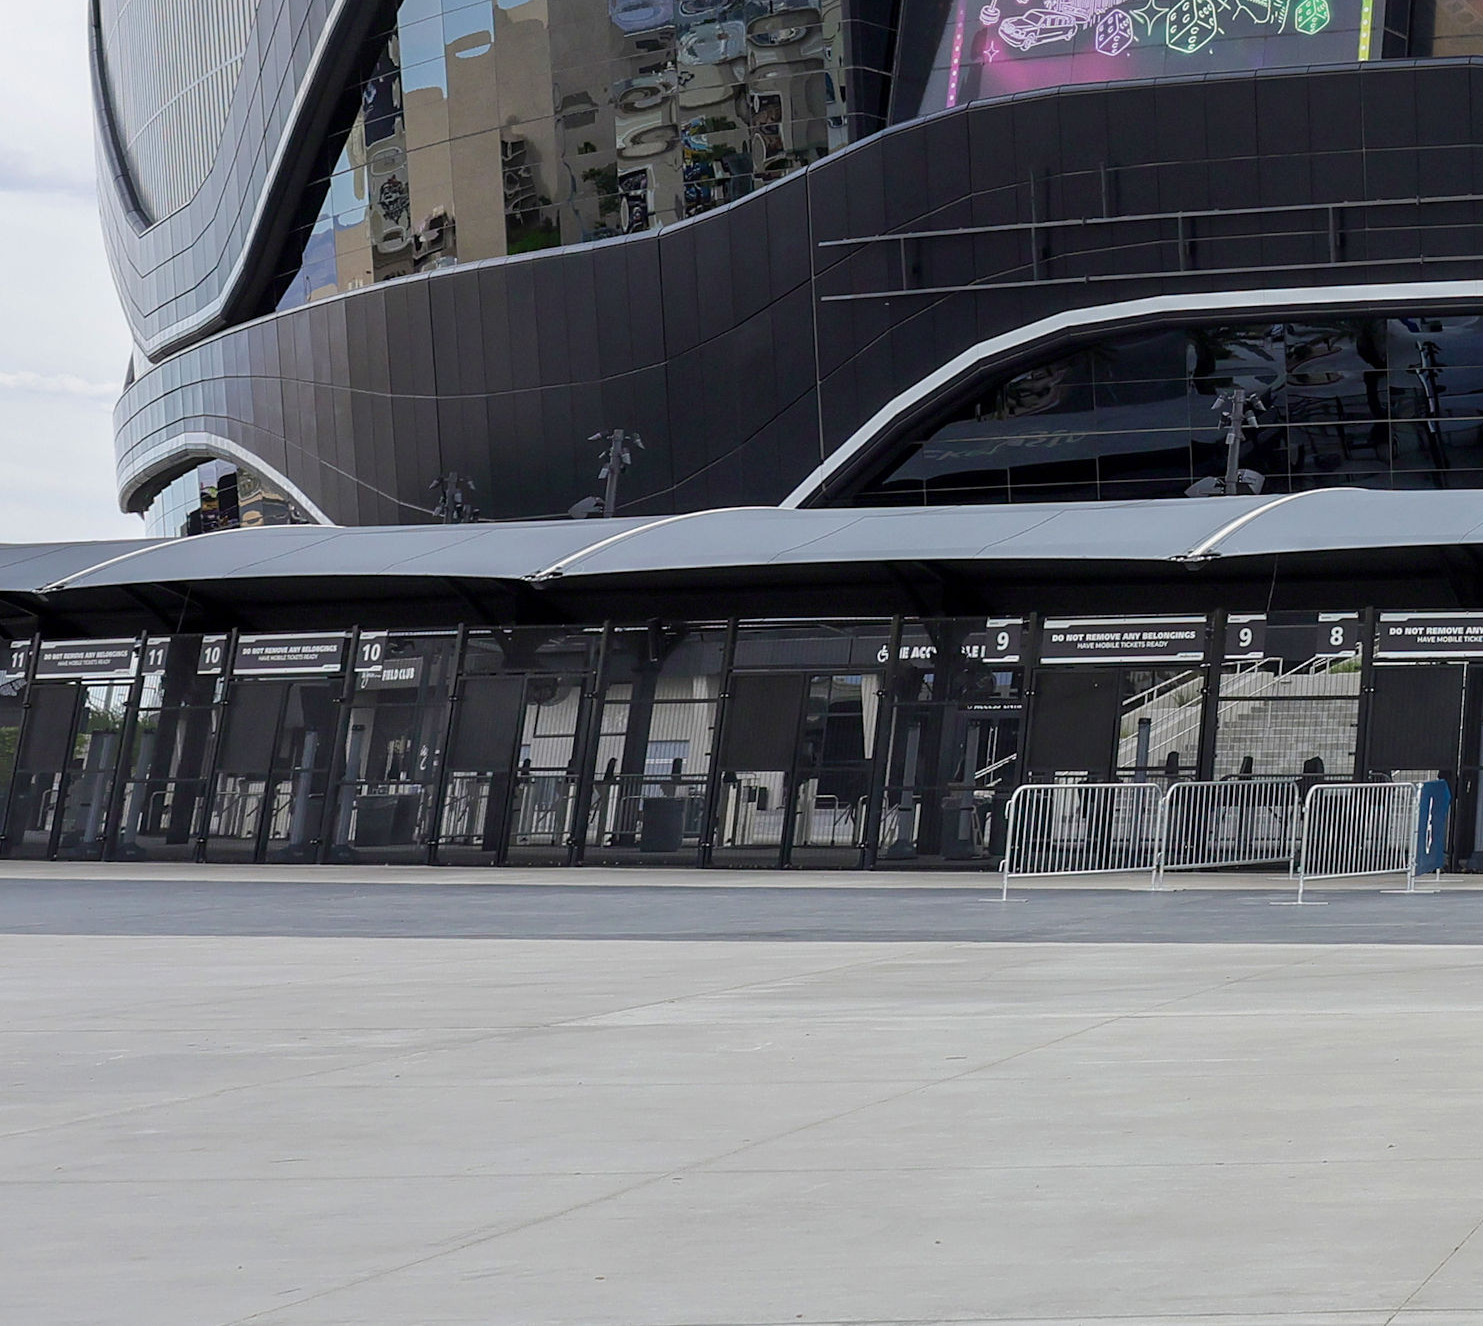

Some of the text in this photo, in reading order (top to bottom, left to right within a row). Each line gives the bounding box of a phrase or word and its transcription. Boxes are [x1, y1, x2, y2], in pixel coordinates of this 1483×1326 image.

[1051, 634, 1064, 642] DO
[1066, 634, 1084, 642] NOT
[1085, 633, 1121, 641] REMOVE
[1142, 631, 1196, 640] BELONGINGS
[1239, 627, 1252, 648] 9
[1329, 626, 1345, 647] 8
[1389, 627, 1403, 635] DO
[1405, 627, 1424, 635] NOT
[1426, 627, 1464, 635] REMOVE
[289, 646, 301, 654] ANY
[301, 645, 337, 653] BELONGINGS
[996, 631, 1010, 651] 9
[1077, 642, 1095, 650] HAVE
[1096, 641, 1120, 649] MOBILE
[1147, 640, 1169, 648] READY
[11, 652, 25, 668] 11
[149, 649, 164, 666] 11
[204, 647, 220, 664] 10
[362, 643, 381, 662] 10
